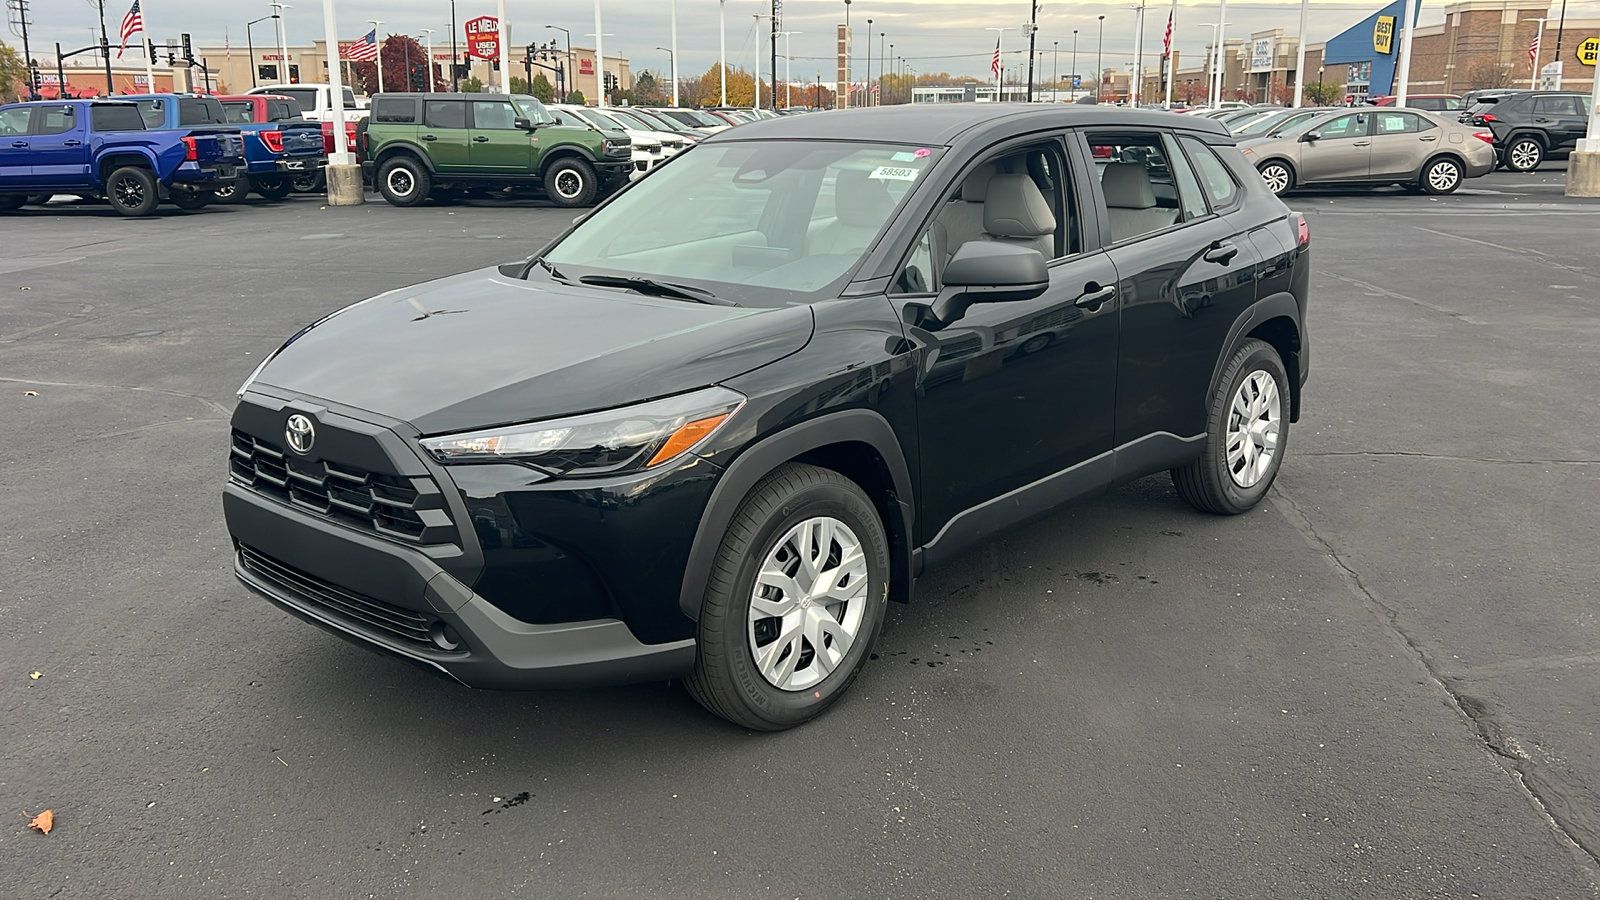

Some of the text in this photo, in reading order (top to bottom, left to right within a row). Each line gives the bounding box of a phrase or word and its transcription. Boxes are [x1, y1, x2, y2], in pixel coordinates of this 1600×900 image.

[468, 19, 499, 34] LE MIEUX
[1377, 22, 1391, 34] BEST
[1376, 35, 1389, 47] BUY
[478, 48, 494, 57] CARS
[43, 75, 67, 83] CHICAO
[879, 167, 912, 177] 58503
[734, 649, 767, 705] MICHELIN
